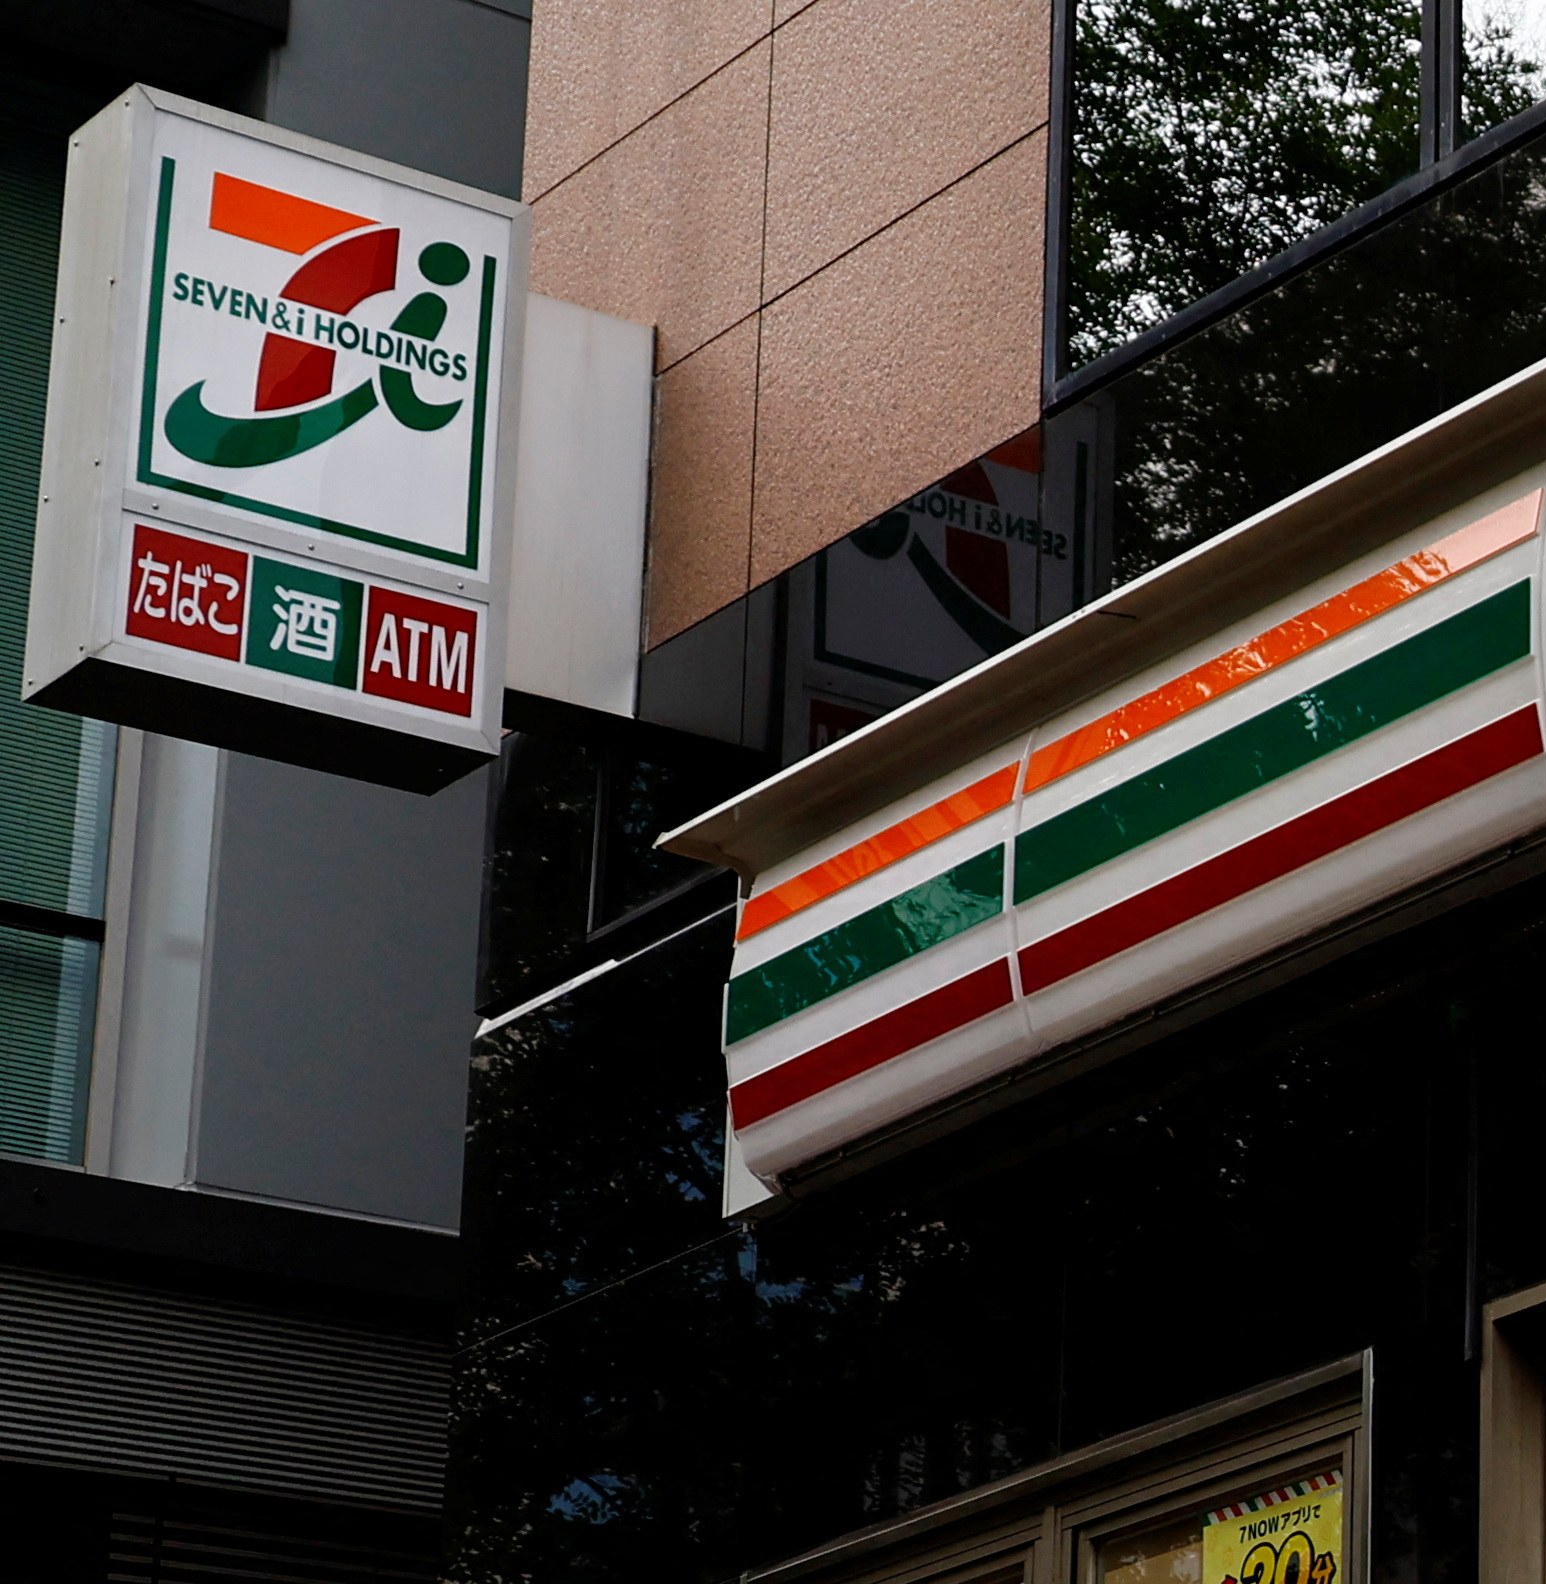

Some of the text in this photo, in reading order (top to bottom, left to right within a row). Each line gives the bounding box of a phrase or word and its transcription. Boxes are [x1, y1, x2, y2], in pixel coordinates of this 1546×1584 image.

[173, 272, 468, 381] SEVEN&i HOLDINGS
[132, 550, 240, 635] たばこ
[269, 587, 341, 662] 酒
[369, 612, 469, 693] ATM
[1238, 1504, 1321, 1544] 7NOWアプリで
